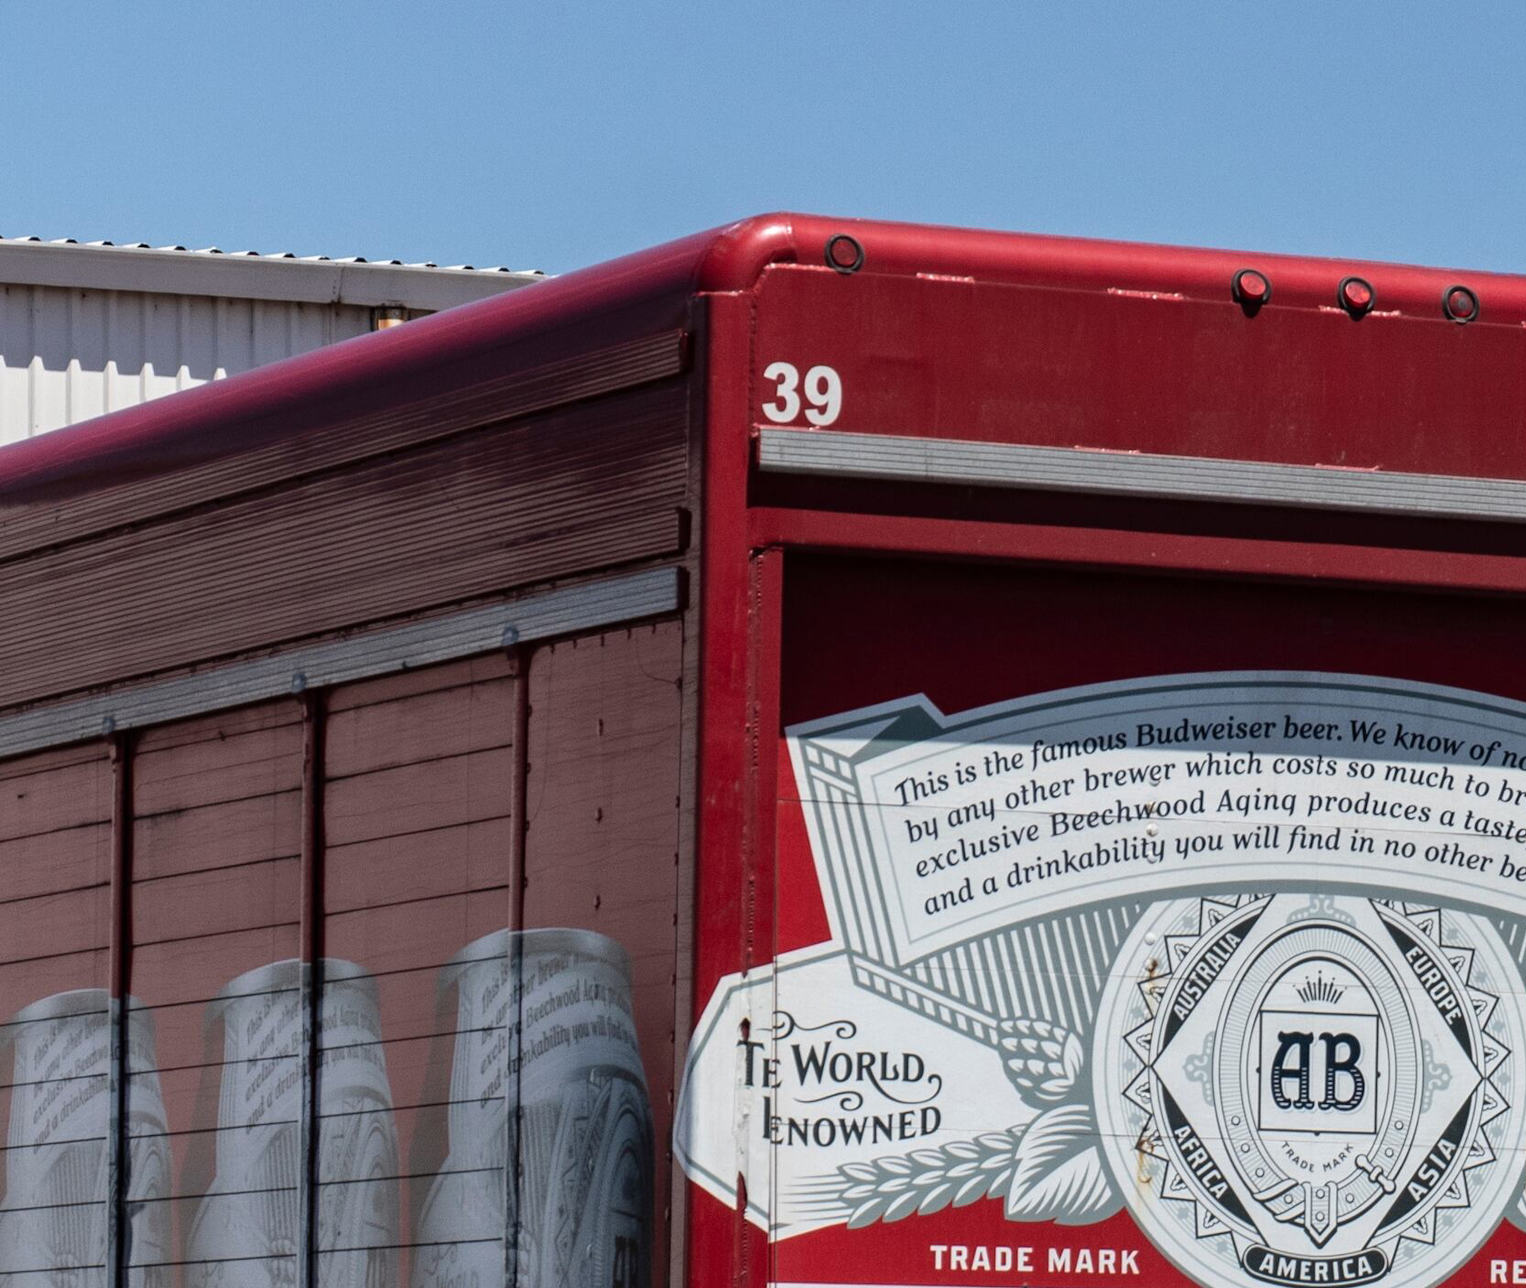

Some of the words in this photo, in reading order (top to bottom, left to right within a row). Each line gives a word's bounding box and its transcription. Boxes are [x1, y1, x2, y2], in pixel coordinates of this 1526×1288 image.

[762, 361, 842, 426] 39
[894, 771, 949, 807] This
[955, 762, 977, 785] is
[984, 751, 1024, 777] the
[1031, 732, 1127, 771] famous
[1135, 718, 1277, 747] Budweiser
[1283, 714, 1342, 741] beer.
[1350, 720, 1387, 745] We
[1393, 723, 1465, 756] know
[1469, 741, 1502, 766] of
[905, 817, 938, 843] by
[948, 798, 995, 827] any
[1005, 779, 1075, 809] other
[1084, 763, 1176, 791] brewer
[1186, 750, 1262, 777] which
[1273, 754, 1337, 776] costs
[1346, 762, 1375, 779] so
[1385, 765, 1454, 791] much
[1465, 774, 1490, 797] to
[916, 825, 1039, 877] exclusive
[1050, 790, 1205, 837] Beechwood
[1307, 792, 1431, 822] produces
[1440, 810, 1455, 827] a
[925, 877, 974, 915] and
[982, 877, 998, 895] a
[1007, 838, 1165, 888] drinkability
[1175, 835, 1223, 859] you
[1233, 825, 1279, 850] will
[1287, 825, 1341, 854] find
[1350, 829, 1374, 853] in
[1384, 839, 1416, 858] no
[1425, 843, 1493, 872] other
[1173, 931, 1242, 1022] AUSTRALIA
[1406, 946, 1463, 1026] EUROPE
[1271, 1030, 1366, 1110] AB
[1173, 1125, 1228, 1201] AFRICA
[1280, 1141, 1315, 1174] TRADE
[1323, 1142, 1356, 1173] MARK
[1407, 1137, 1457, 1203] ASIA
[930, 1244, 1034, 1273] TRADE
[1047, 1247, 1140, 1275] MARK
[1258, 1255, 1373, 1282] AMERICA
